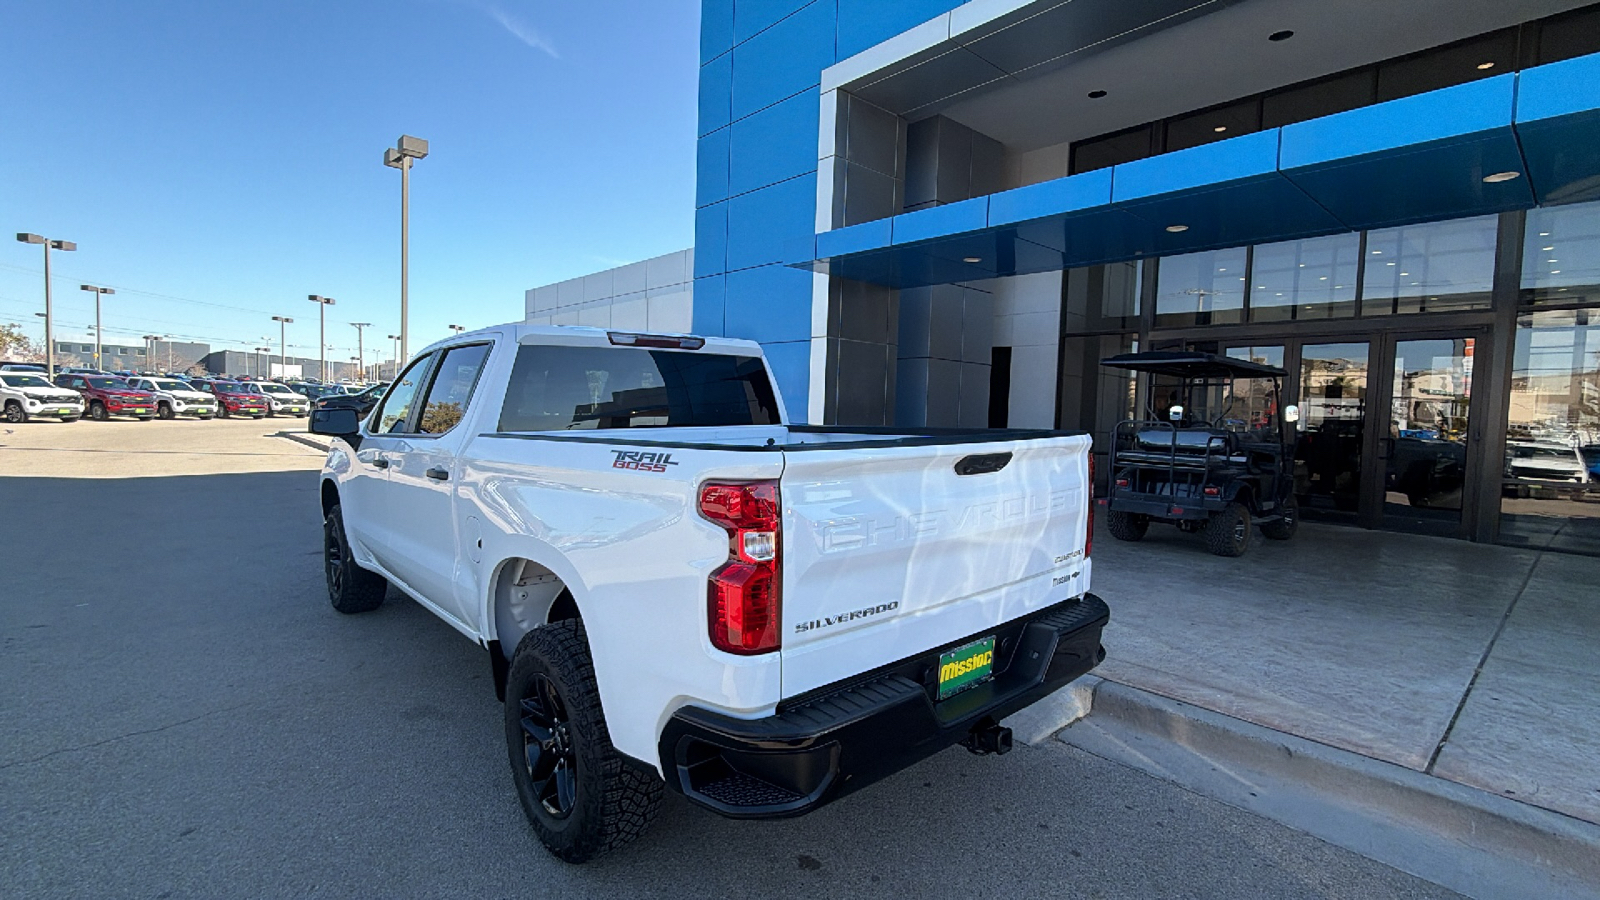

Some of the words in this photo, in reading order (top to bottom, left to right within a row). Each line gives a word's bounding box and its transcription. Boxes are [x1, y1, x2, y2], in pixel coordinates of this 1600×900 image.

[610, 449, 679, 466] TRAIL
[612, 460, 668, 473] BOSS
[822, 486, 1083, 553] CHEVROLET
[794, 600, 899, 634] SILVERADO
[940, 650, 992, 684] Mission
